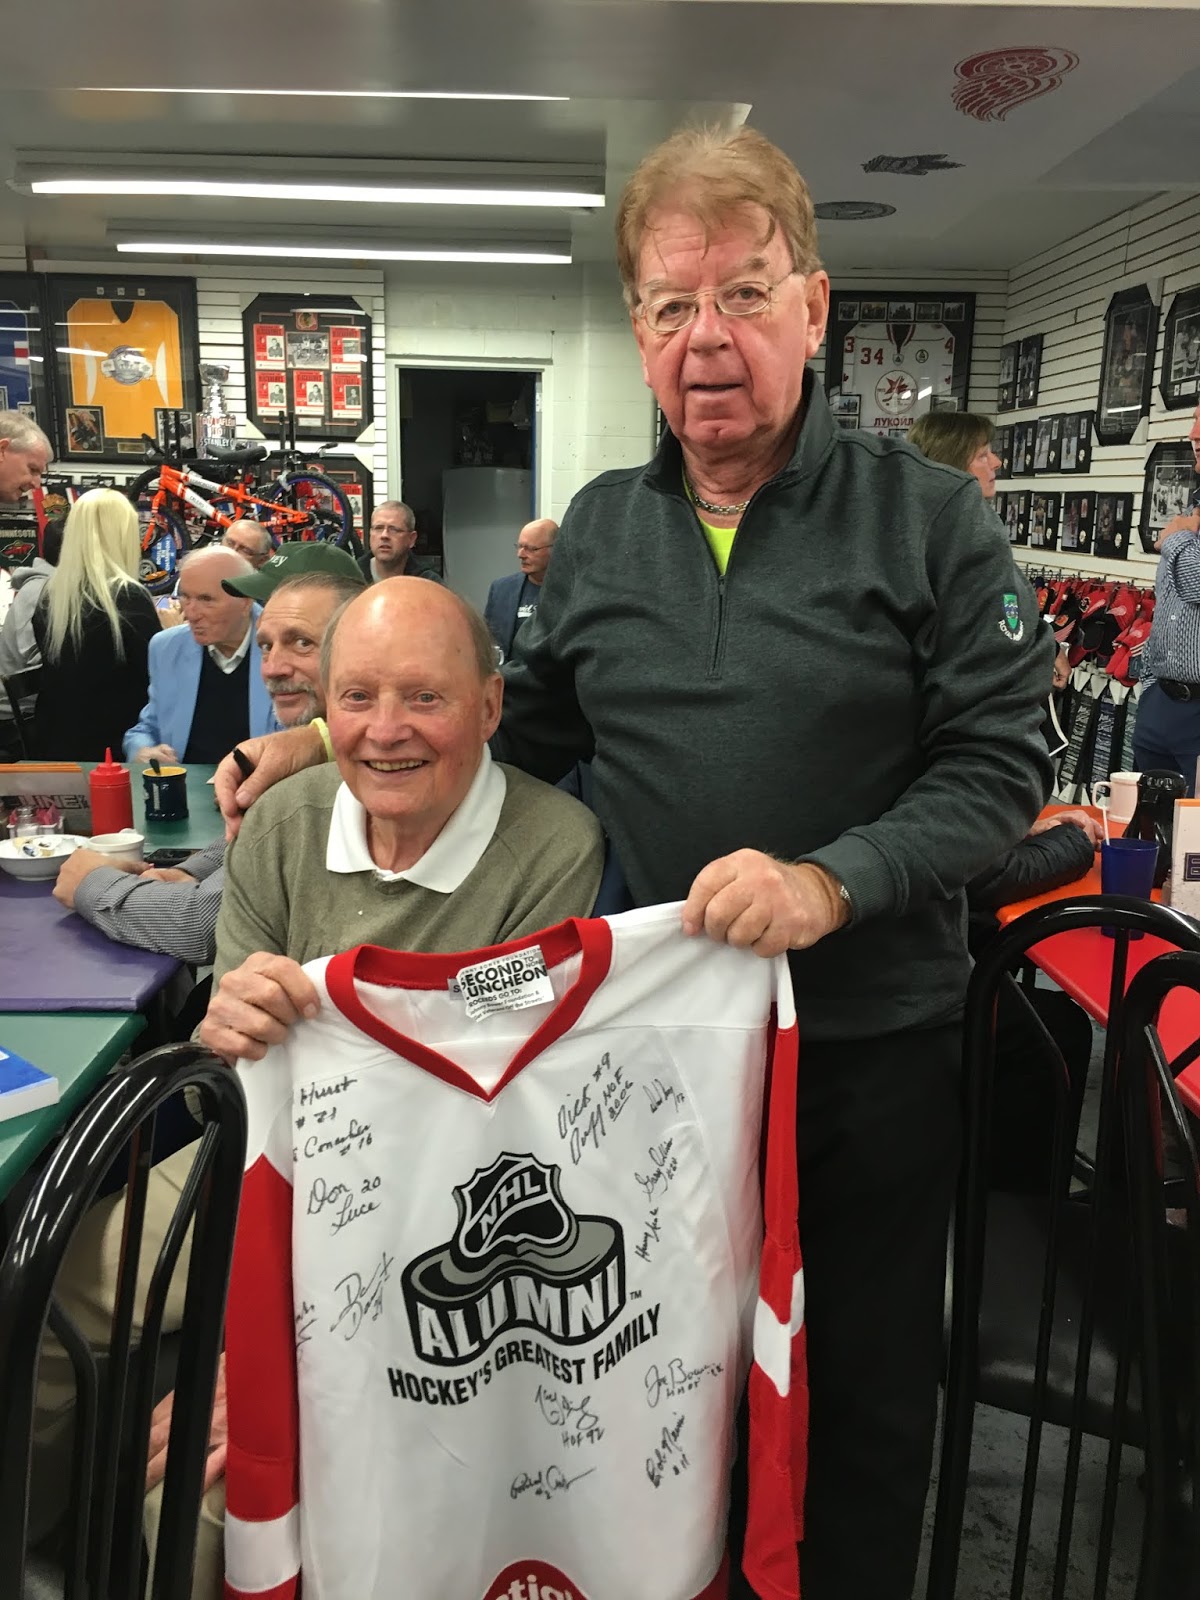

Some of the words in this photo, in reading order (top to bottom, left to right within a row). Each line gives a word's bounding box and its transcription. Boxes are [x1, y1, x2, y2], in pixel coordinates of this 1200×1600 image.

[860, 347, 884, 365] 34
[465, 965, 548, 1000] UNCHEON
[479, 1170, 542, 1240] NHL
[415, 1255, 621, 1359] ALUMNI
[386, 1359, 493, 1406] HOCKEY'S
[494, 1339, 586, 1385] GREATEST
[592, 1302, 661, 1380] FAMILY
